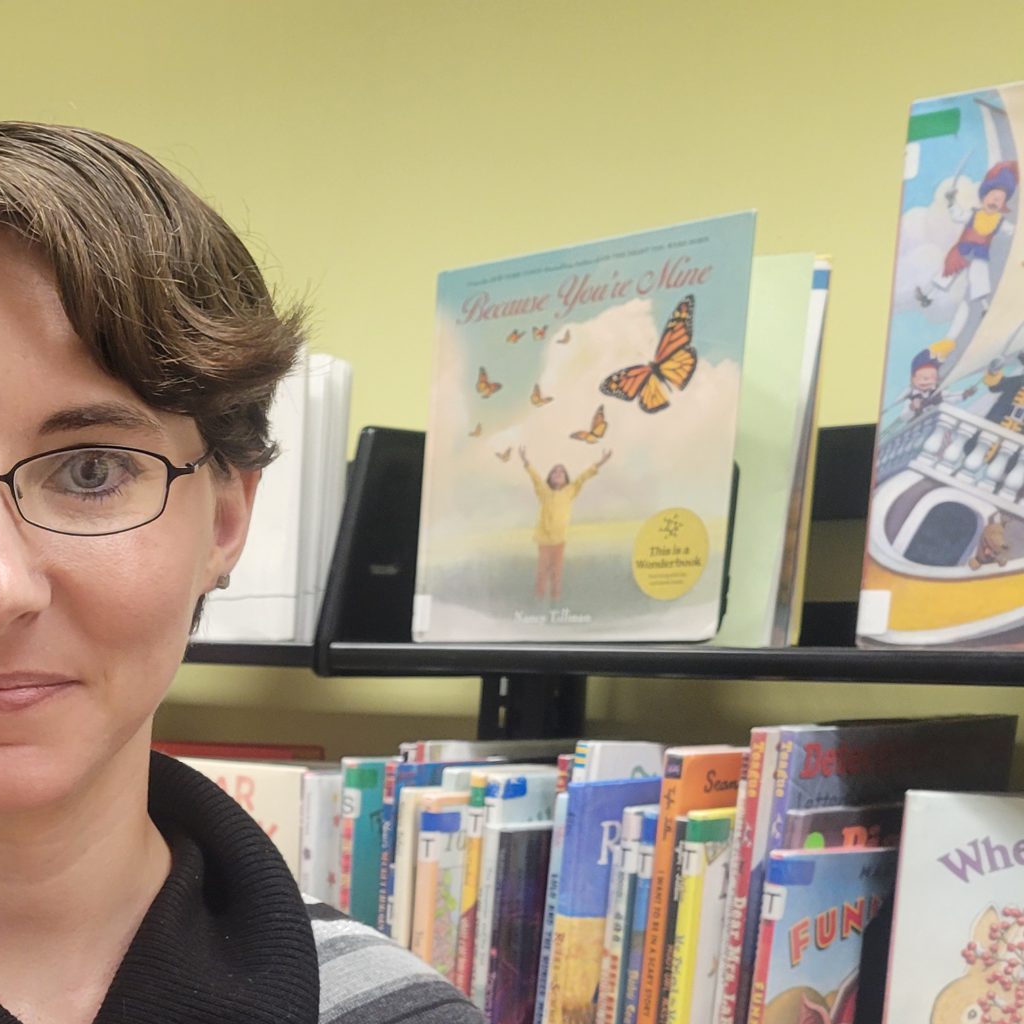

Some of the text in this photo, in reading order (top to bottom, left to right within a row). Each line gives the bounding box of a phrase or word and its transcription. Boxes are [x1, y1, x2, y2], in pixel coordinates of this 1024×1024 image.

[456, 290, 551, 325] Because
[554, 271, 633, 319] You're
[635, 254, 713, 295] Mine
[747, 741, 765, 798] Teague
[775, 741, 793, 798] Teague
[422, 838, 435, 858] T
[732, 896, 746, 942] Dear
[764, 891, 781, 916] T
[648, 957, 657, 986] SCARY
[724, 951, 742, 988] Mrs.
[643, 988, 653, 1017] STORY
